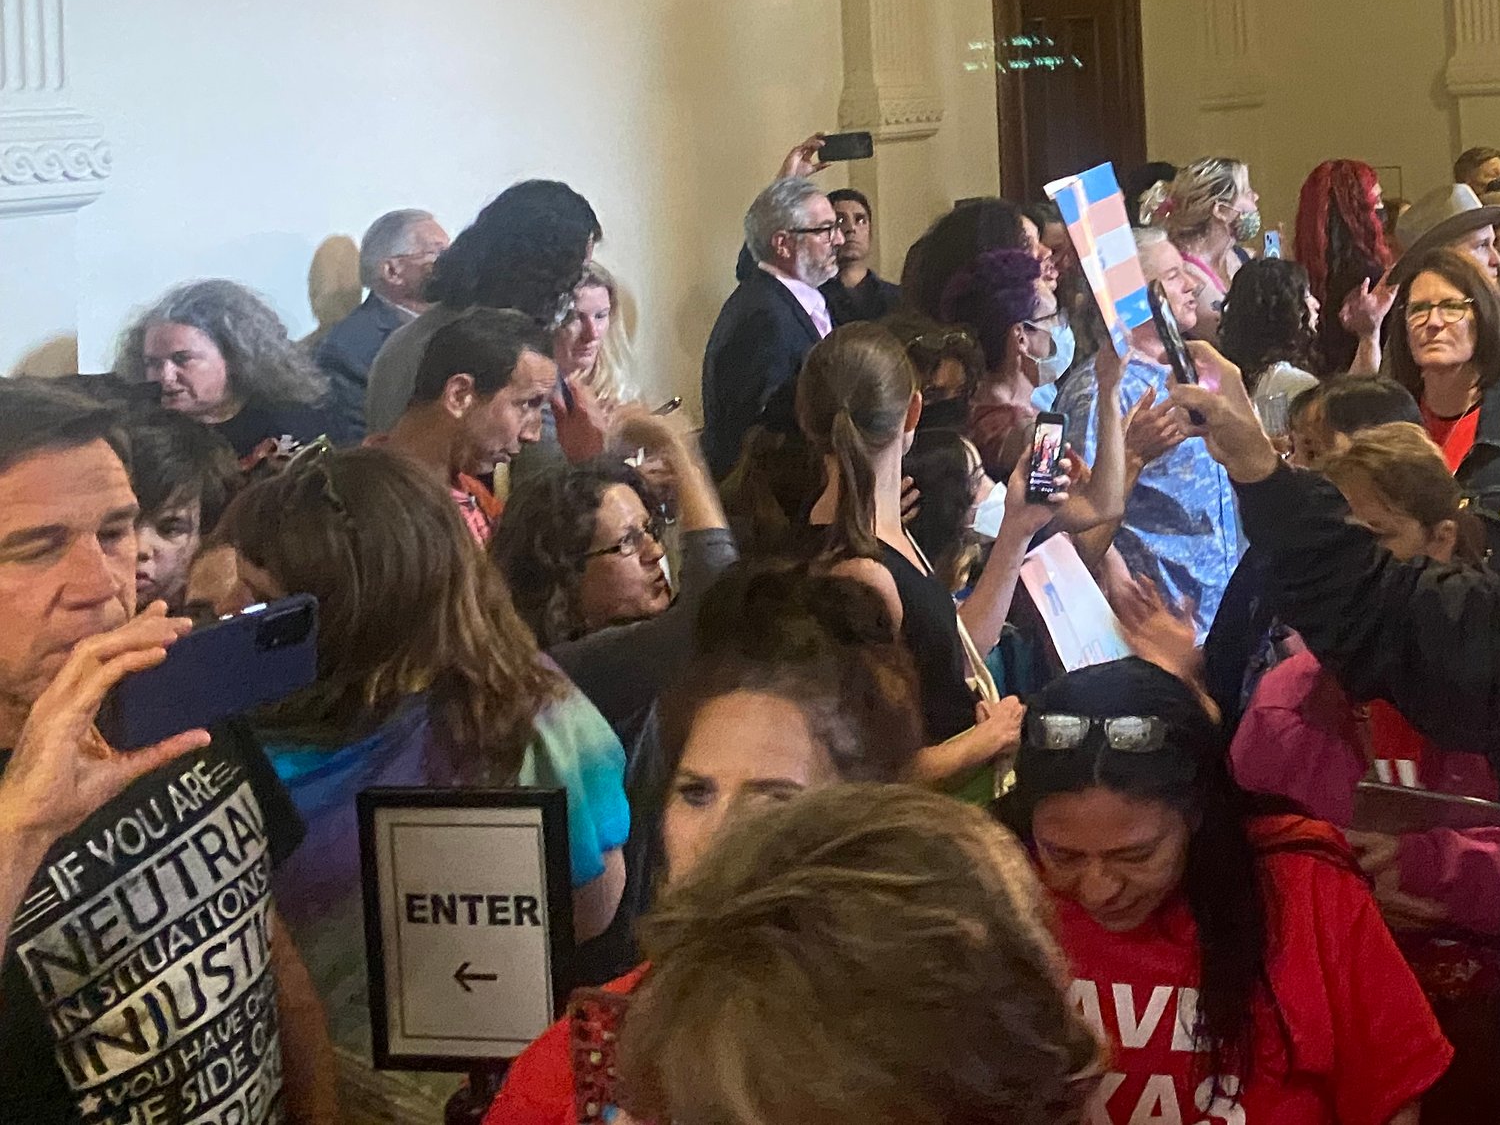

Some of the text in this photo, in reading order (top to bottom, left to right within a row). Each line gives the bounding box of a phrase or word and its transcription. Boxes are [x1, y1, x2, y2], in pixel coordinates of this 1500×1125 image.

[48, 760, 220, 901] IF YOU ARE
[406, 892, 541, 926] ENTER
[51, 990, 92, 1040] IN
[60, 905, 271, 1085] INJUSTI
[105, 1058, 175, 1107] YOU
[178, 1007, 244, 1072] HAVE
[181, 1040, 249, 1115] SIDE
